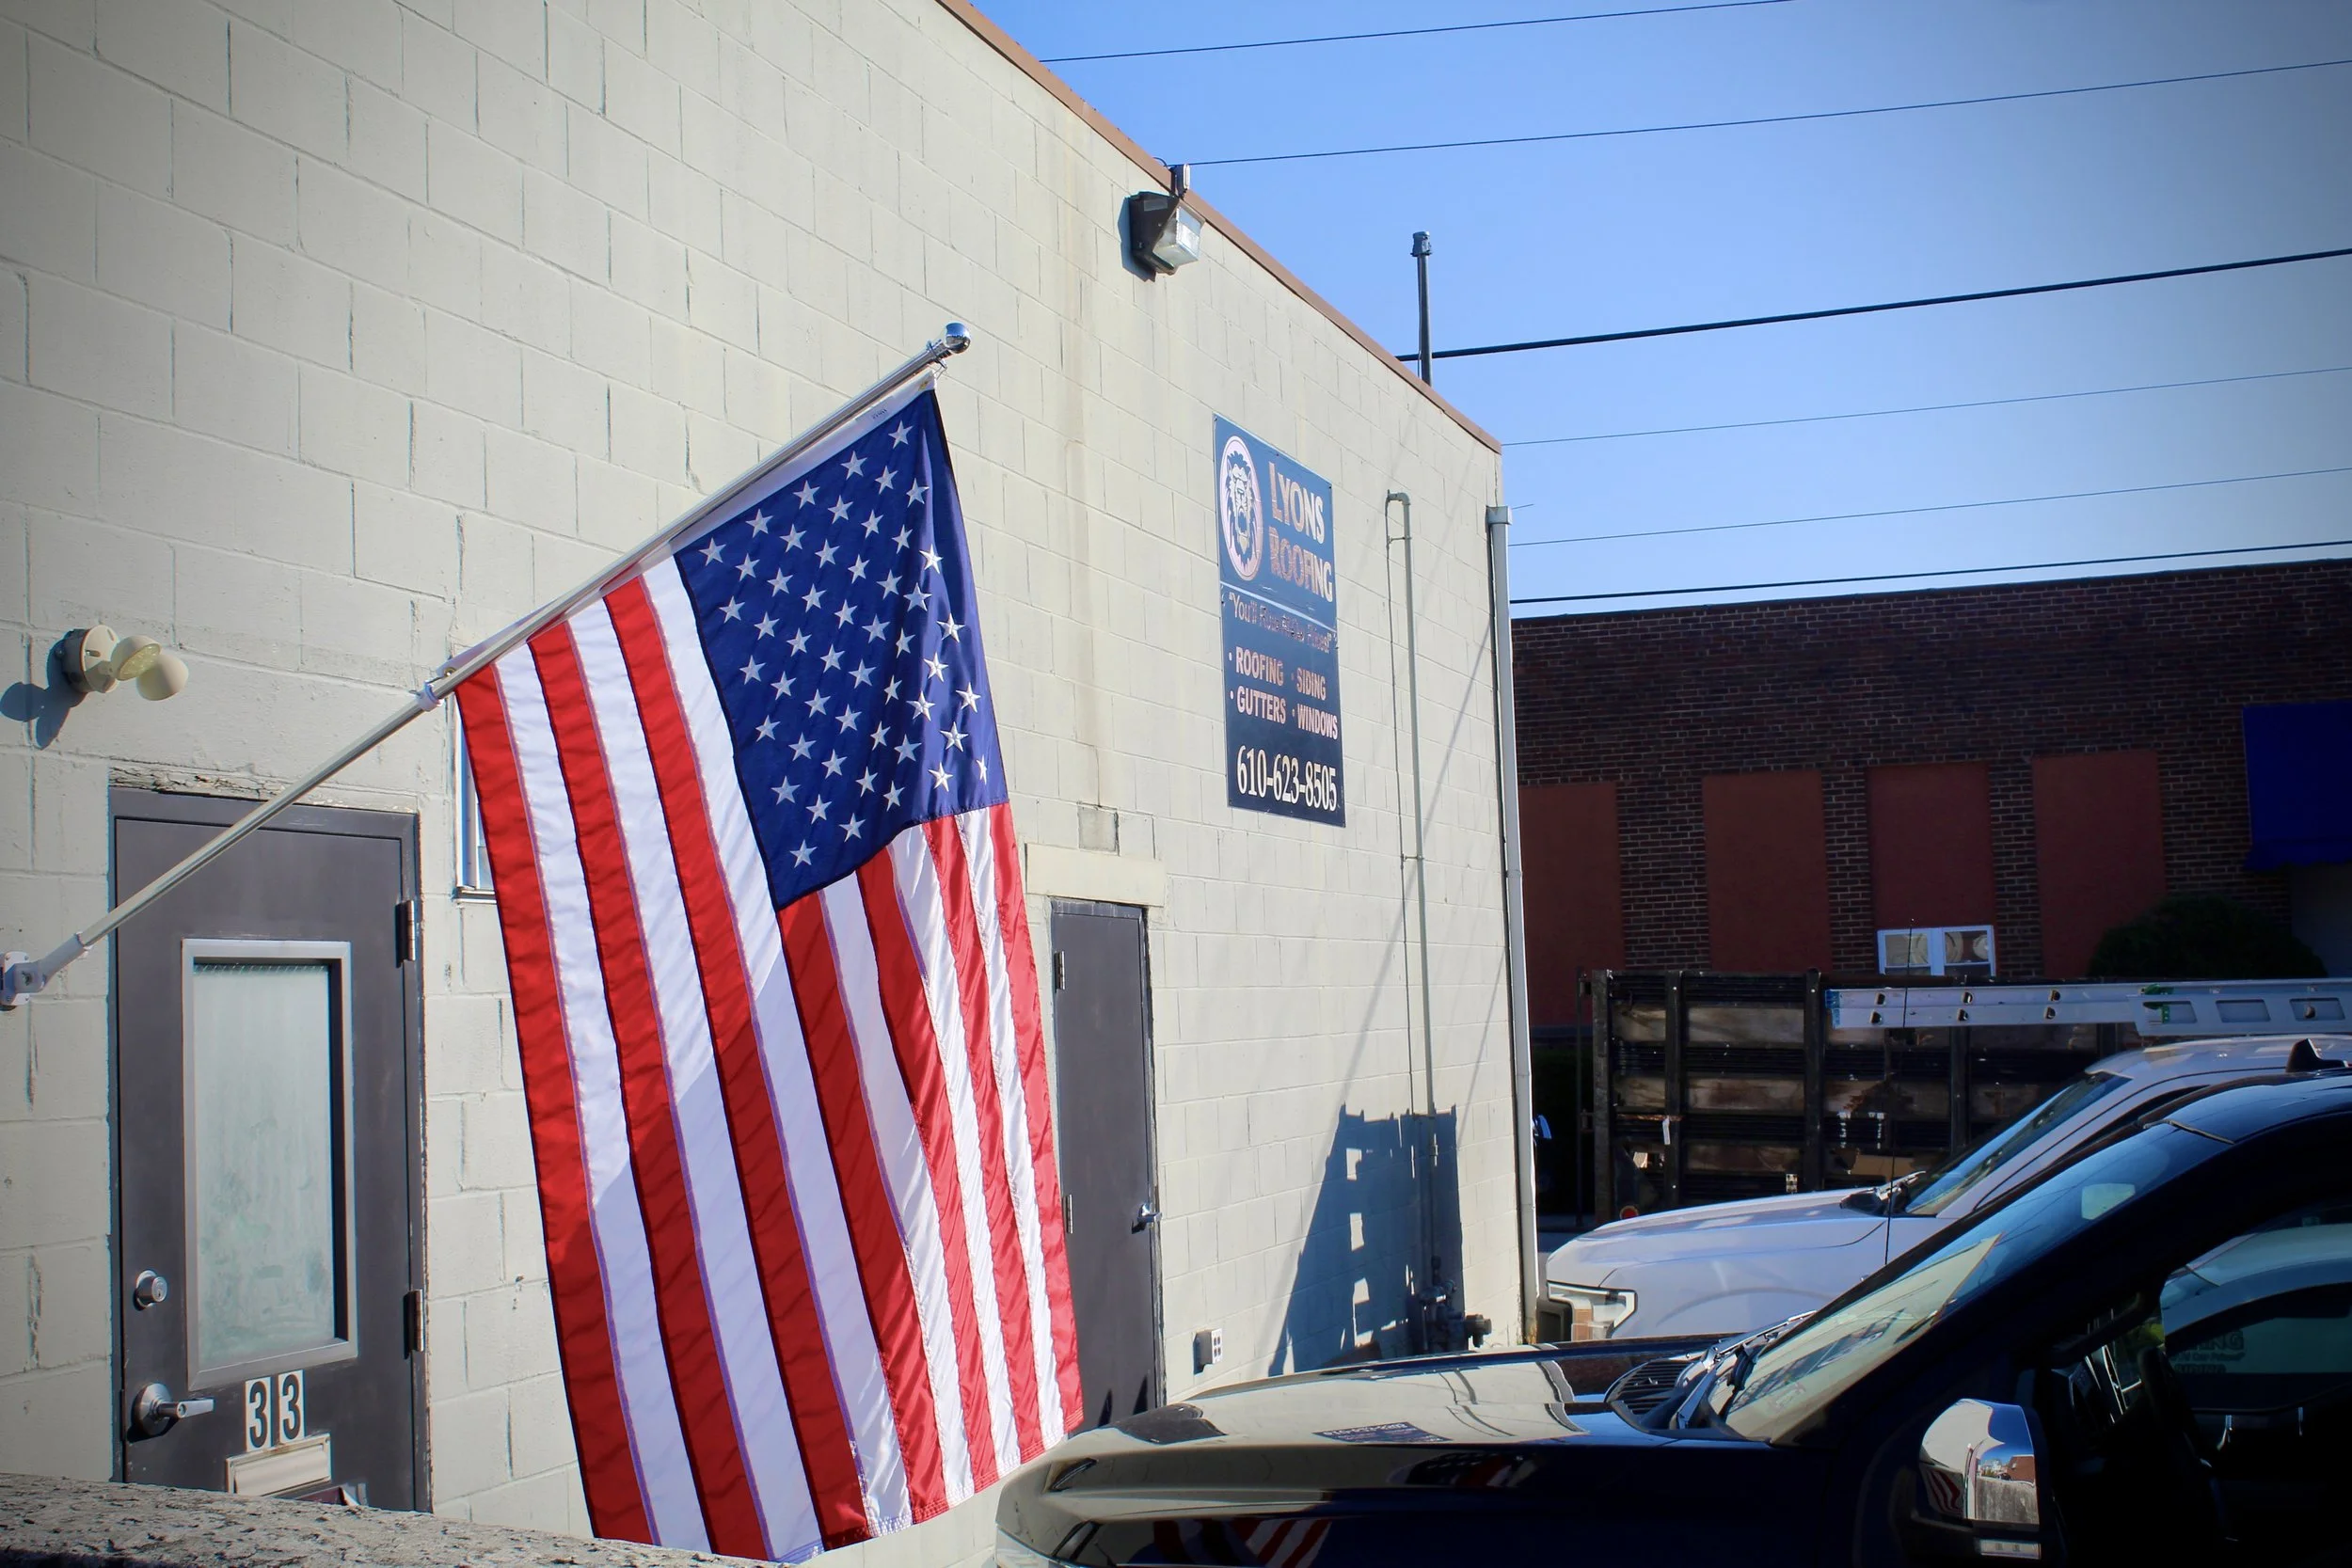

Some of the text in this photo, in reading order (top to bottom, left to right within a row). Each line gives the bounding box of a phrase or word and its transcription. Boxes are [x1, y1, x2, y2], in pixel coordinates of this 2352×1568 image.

[1269, 461, 1325, 545] LYONS
[1269, 527, 1333, 603] ROOFING
[1235, 646, 1327, 701] ROOFING SIDING
[1236, 686, 1338, 740] GUTTERS WINDOWS
[1236, 745, 1338, 812] 610-623-8505
[248, 1373, 301, 1449] 33
